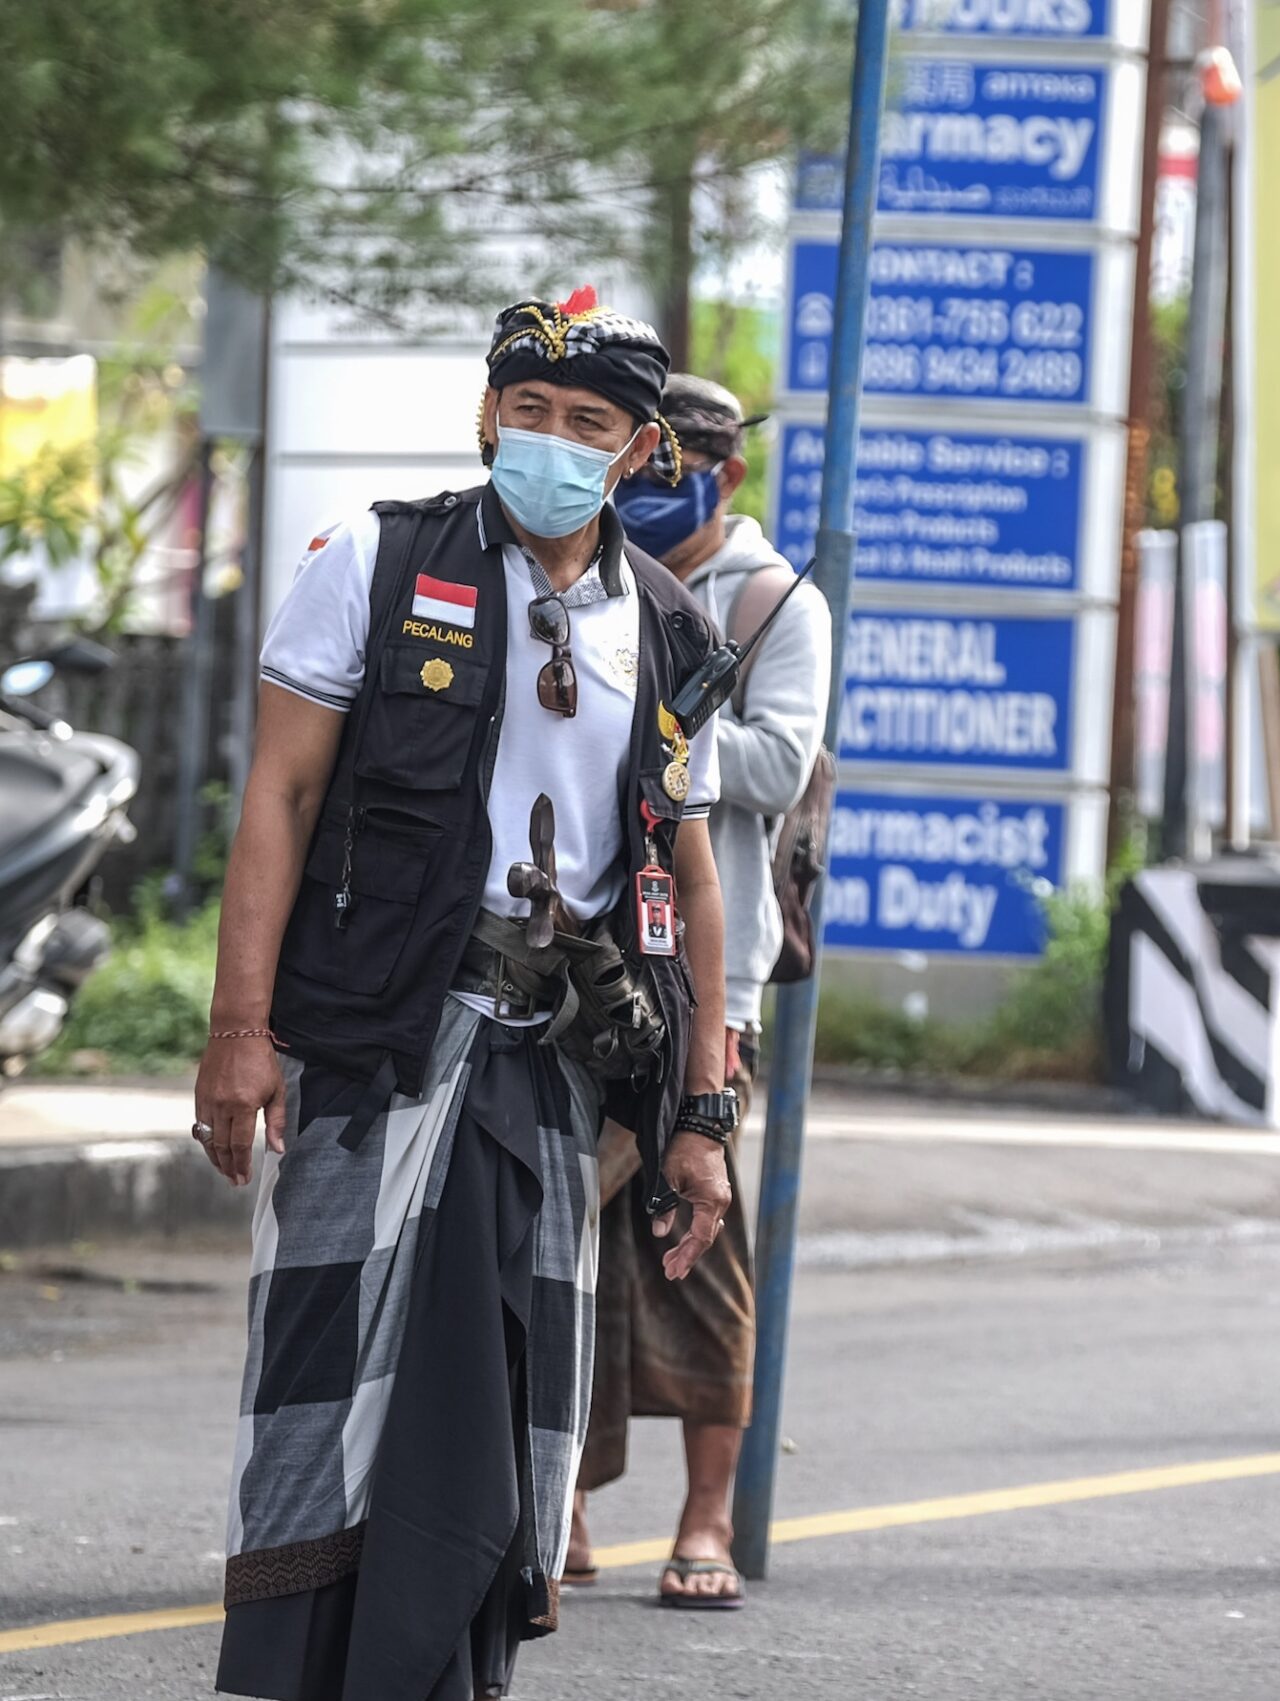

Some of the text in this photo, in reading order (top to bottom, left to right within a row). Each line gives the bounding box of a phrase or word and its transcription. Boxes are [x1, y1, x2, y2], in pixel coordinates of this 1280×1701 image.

[877, 112, 1095, 180] armacy
[868, 247, 1013, 289] ONTACT
[927, 435, 1049, 478] Service
[402, 619, 473, 648] PECALANG
[832, 801, 1049, 868] armacist
[876, 864, 998, 948] Duty
